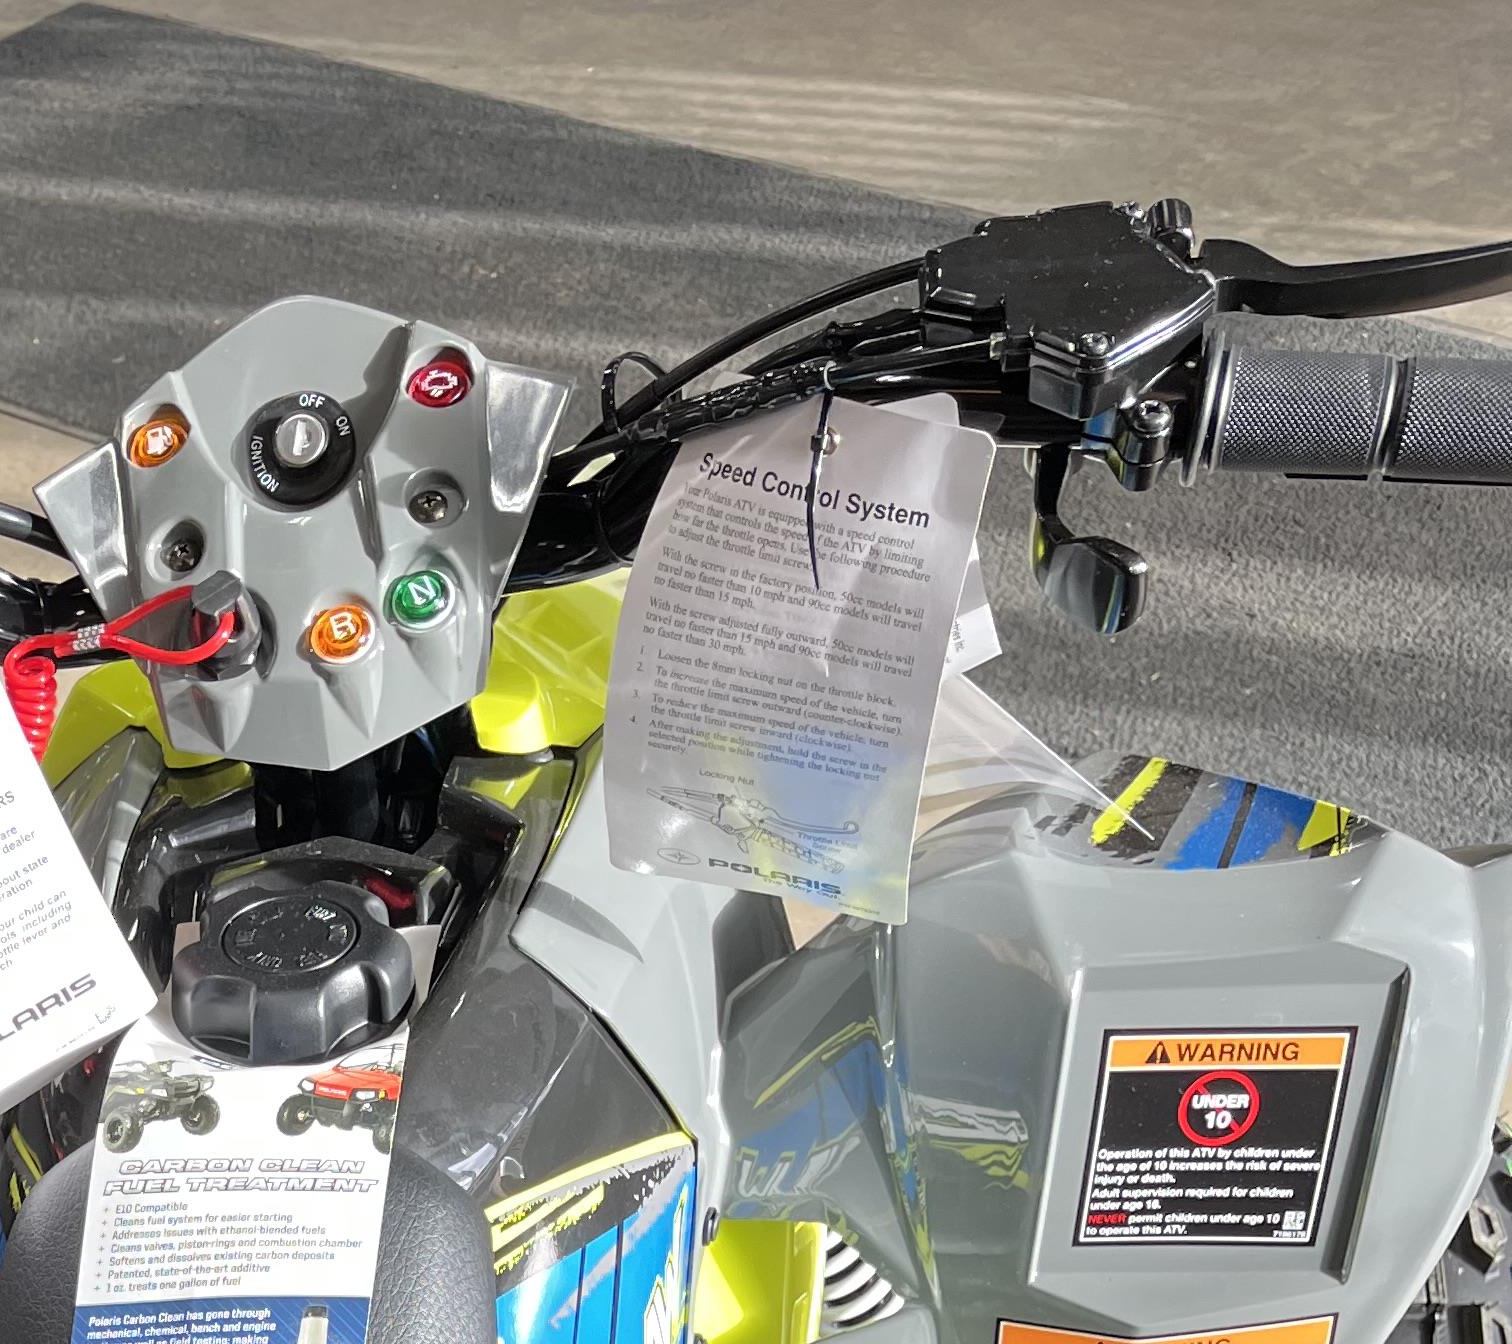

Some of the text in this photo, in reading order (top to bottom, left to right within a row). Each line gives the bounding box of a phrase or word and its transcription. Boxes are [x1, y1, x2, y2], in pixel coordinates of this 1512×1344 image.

[299, 393, 325, 408] OFF
[335, 415, 351, 437] ON
[251, 435, 280, 493] IGNITION
[699, 452, 757, 487] Speed
[845, 493, 929, 528] System
[408, 574, 438, 605] N
[0, 826, 18, 841] are
[1173, 1042, 1301, 1061] WARNING
[1190, 1094, 1250, 1109] UNDER
[1202, 1110, 1233, 1129] 10
[1097, 1147, 1316, 1160] Operation of this ATV by children under
[118, 1156, 366, 1175] CARBON CLEAN
[102, 1173, 380, 1196] FUEL TREATMENT
[1087, 1213, 1280, 1225] NEVER permit children under age 10
[88, 1307, 271, 1326] Polaris Carbon Clean has gone through
